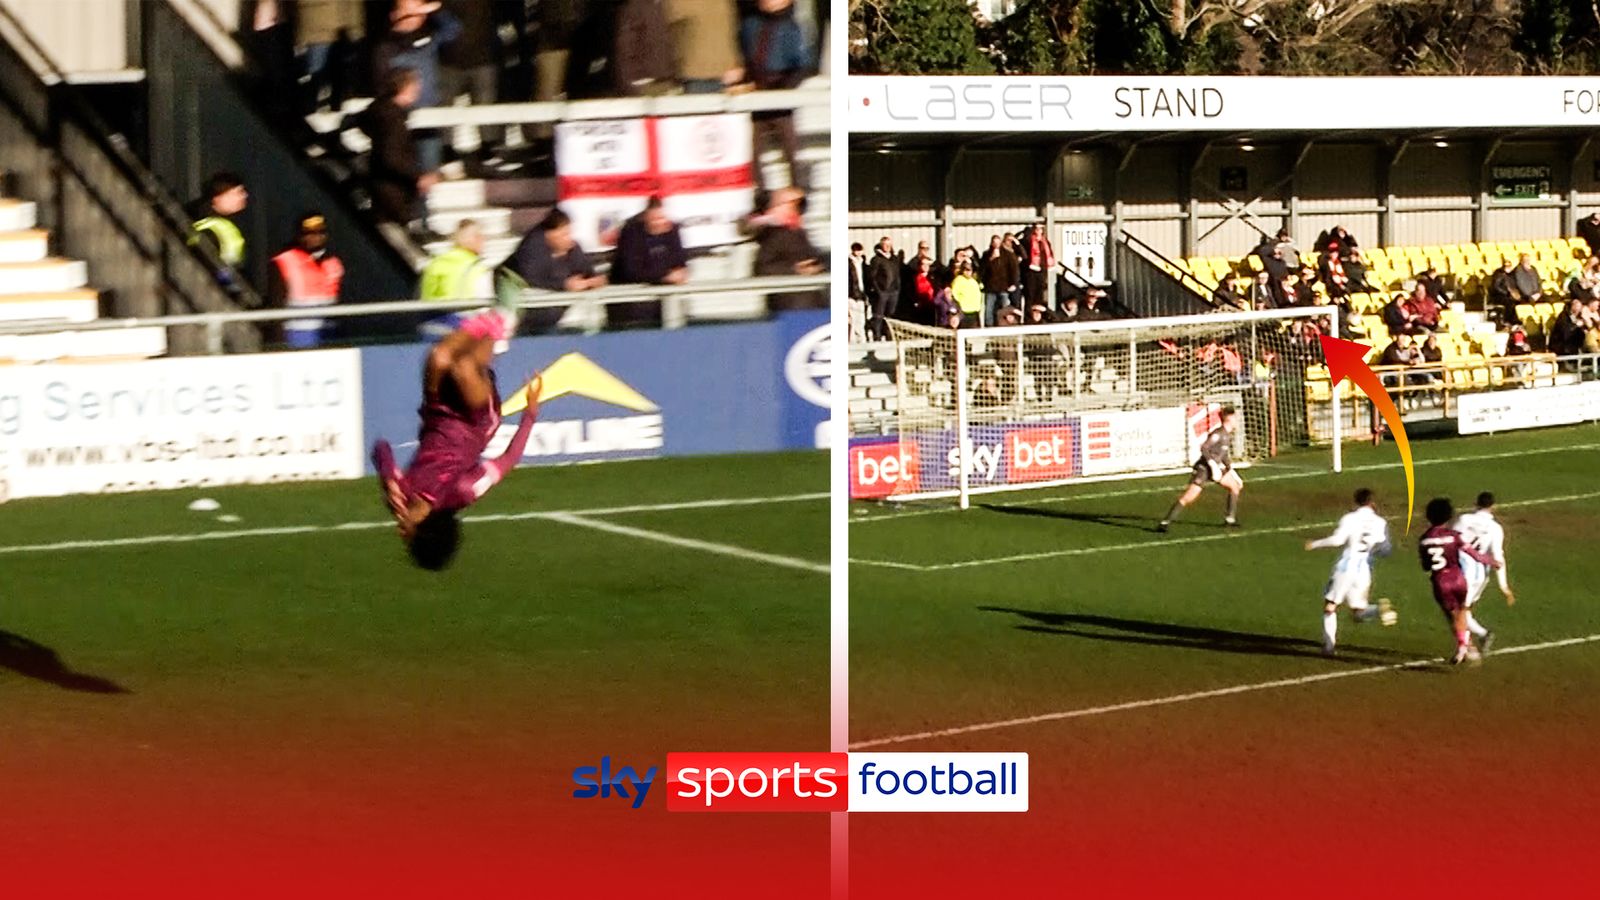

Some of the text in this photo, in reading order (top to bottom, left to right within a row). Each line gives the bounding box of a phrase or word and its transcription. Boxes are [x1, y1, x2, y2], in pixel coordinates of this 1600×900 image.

[1114, 86, 1223, 118] STAND
[1563, 89, 1600, 114] FO
[1514, 184, 1536, 195] EXIT
[1065, 230, 1106, 246] TOILETS
[43, 378, 254, 421] Services
[272, 369, 345, 412] Ltd
[1013, 433, 1066, 469] bet
[857, 450, 913, 486] bet
[1427, 547, 1447, 571] 3
